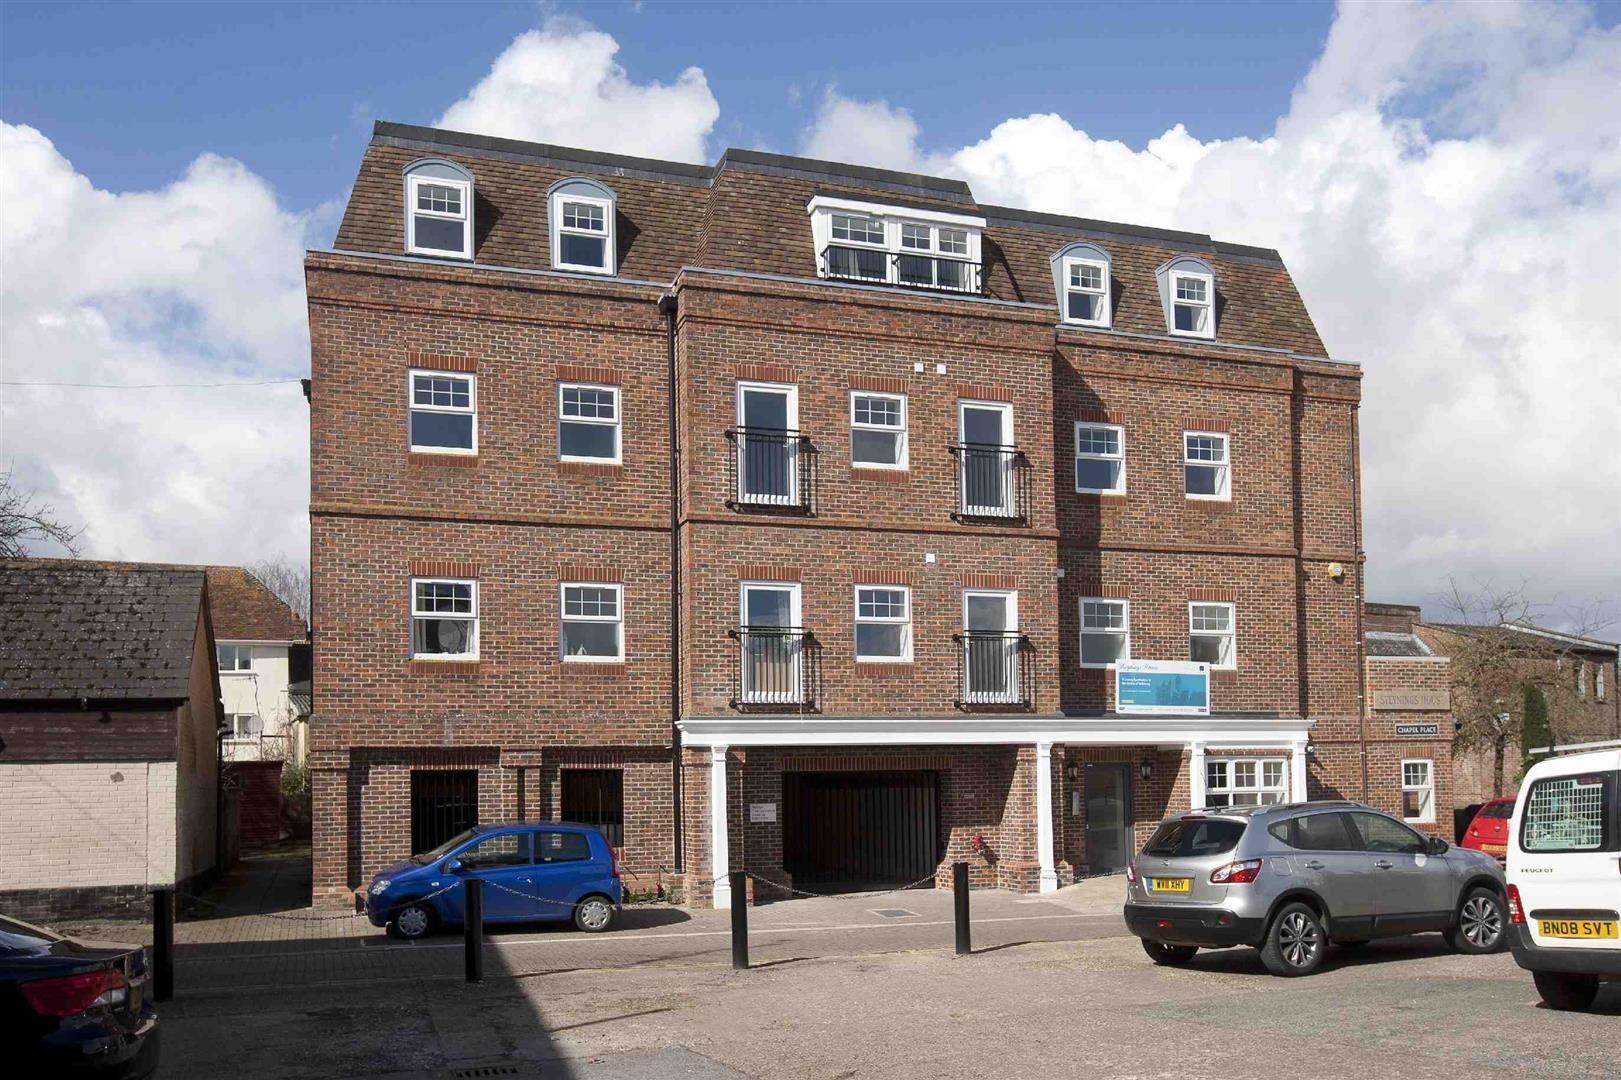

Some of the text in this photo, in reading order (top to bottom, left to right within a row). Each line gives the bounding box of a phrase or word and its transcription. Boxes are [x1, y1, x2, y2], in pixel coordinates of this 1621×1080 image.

[1171, 880, 1184, 889] XHY
[1543, 921, 1612, 935] BN08 SVT
